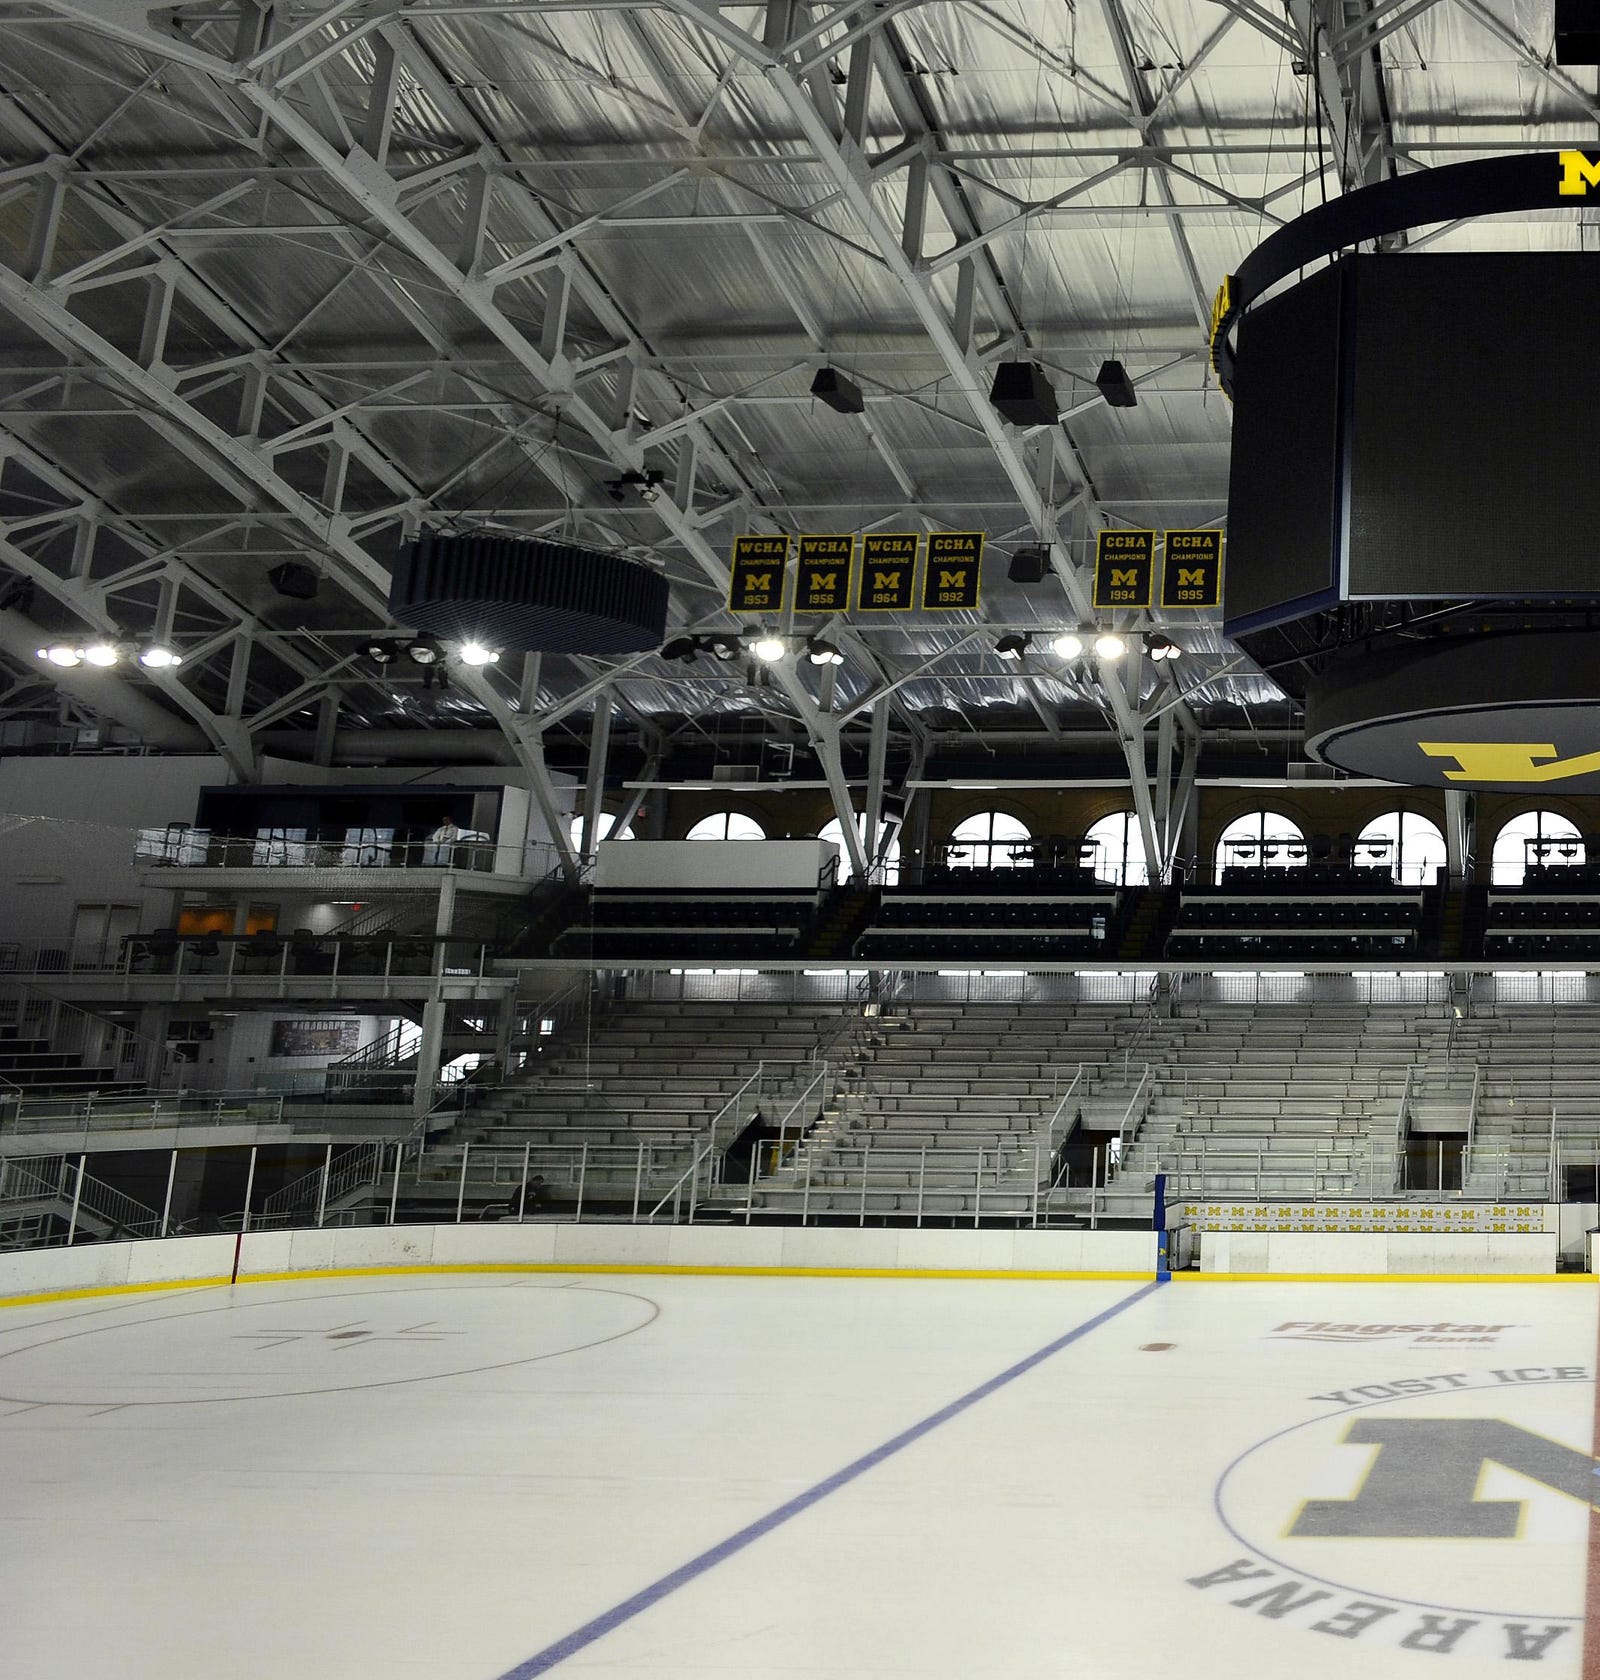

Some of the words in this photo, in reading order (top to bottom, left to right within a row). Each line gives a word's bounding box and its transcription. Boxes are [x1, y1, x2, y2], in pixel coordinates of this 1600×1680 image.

[740, 542, 784, 553] WCHA
[804, 542, 848, 552] WCHA
[868, 541, 913, 552] WCHA
[935, 539, 975, 550] CCHA
[1106, 537, 1146, 548] CCHA
[1173, 537, 1213, 547] CCHA
[745, 574, 771, 590] M
[810, 573, 837, 590] M
[873, 572, 901, 589] M
[939, 571, 966, 588] M
[1110, 569, 1138, 586] M
[1177, 569, 1205, 585] M
[744, 595, 769, 604] 1953
[809, 594, 834, 604] 1956
[873, 593, 897, 603] 1964
[939, 592, 964, 602] 1992
[1111, 590, 1135, 600] 1994
[1178, 590, 1203, 600] 1995
[1271, 1321, 1515, 1335] Flagstar
[1413, 1335, 1500, 1343] Bank
[1307, 1374, 1468, 1405] YOST
[1489, 1366, 1589, 1383] ICE
[1184, 1558, 1571, 1661] ARENA
